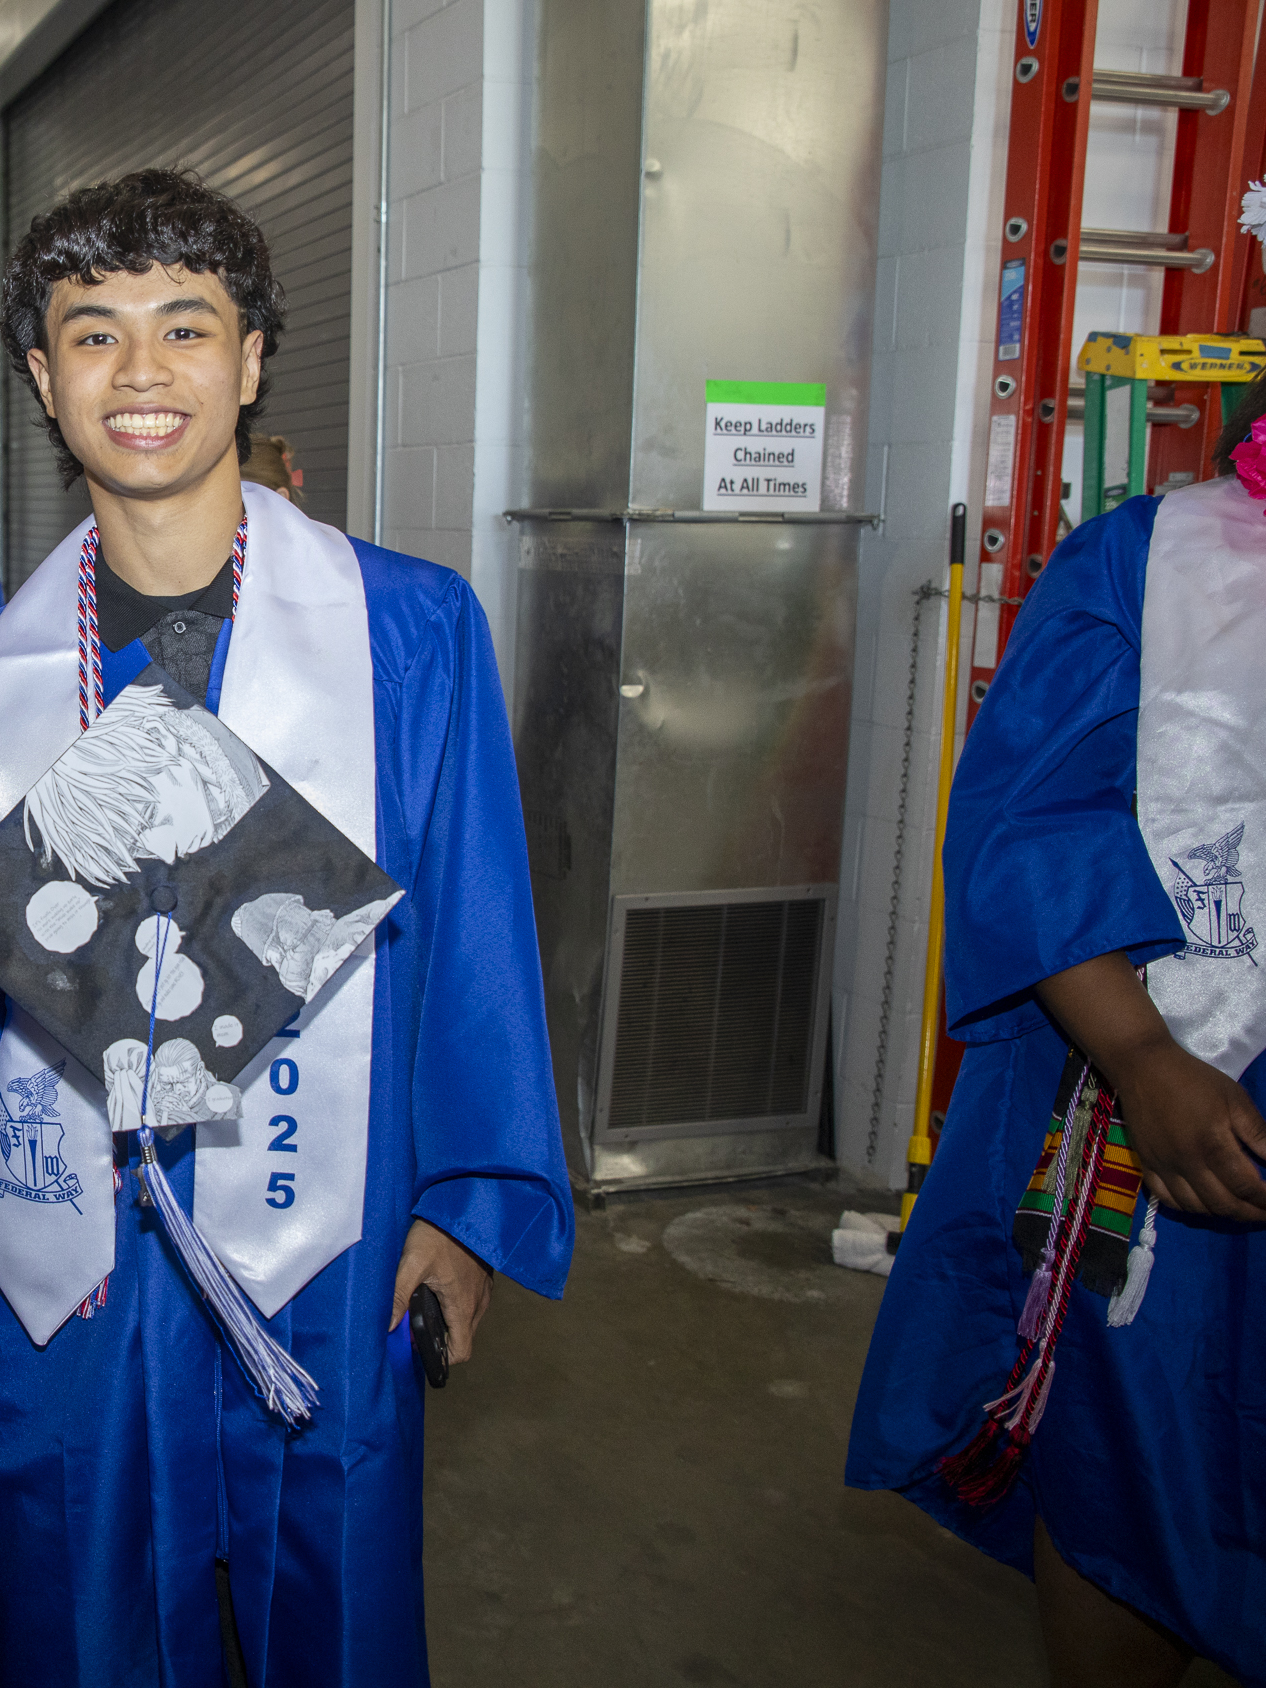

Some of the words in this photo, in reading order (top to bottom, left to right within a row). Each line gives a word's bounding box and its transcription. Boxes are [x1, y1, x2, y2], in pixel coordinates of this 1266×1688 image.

[1189, 362, 1245, 371] WERNER
[714, 417, 752, 435] Keep
[758, 418, 815, 435] Ladders
[734, 447, 794, 464] Chained
[718, 478, 734, 492] At
[740, 478, 759, 493] All
[764, 479, 807, 494] Times
[1186, 945, 1232, 956] EDERAL
[1235, 941, 1256, 955] WAY
[53, 1185, 79, 1200] WAY
